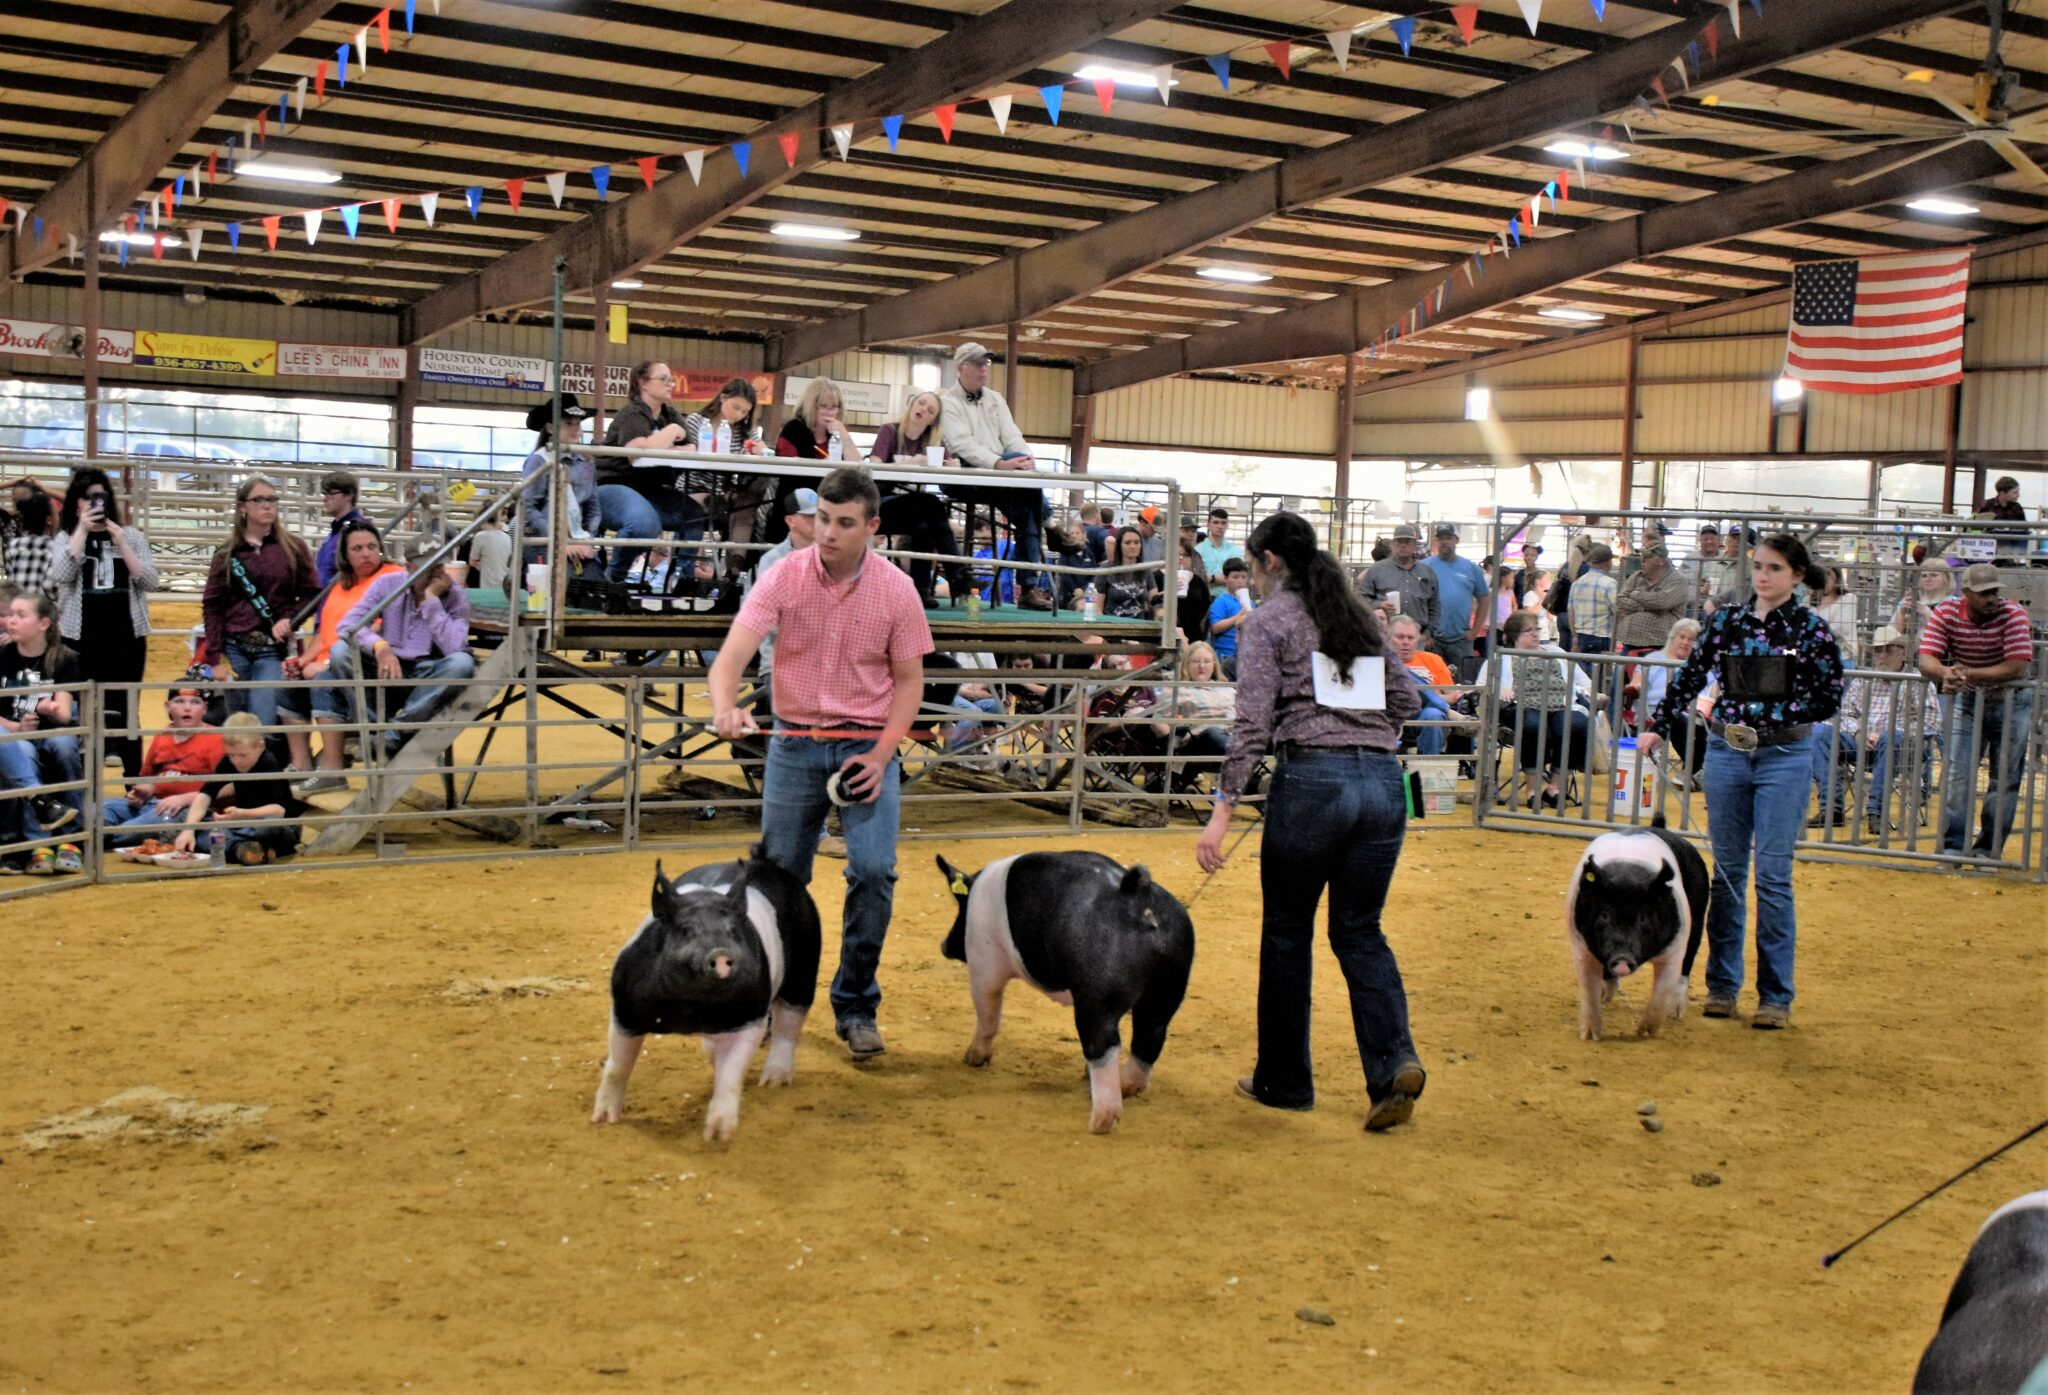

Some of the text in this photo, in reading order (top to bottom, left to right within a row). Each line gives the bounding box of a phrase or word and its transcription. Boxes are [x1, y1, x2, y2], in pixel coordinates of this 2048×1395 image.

[97, 337, 133, 358] Bros
[143, 331, 236, 357] Signs by Debbie
[153, 357, 243, 372] 936-867-4399
[284, 351, 400, 369] LEE'S CHINA INN
[424, 350, 541, 371] HOUSTON COUNTY
[314, 367, 345, 375] SQUARE
[425, 361, 502, 377] NURSING HOME
[562, 363, 595, 378] ARM
[843, 388, 870, 398] County
